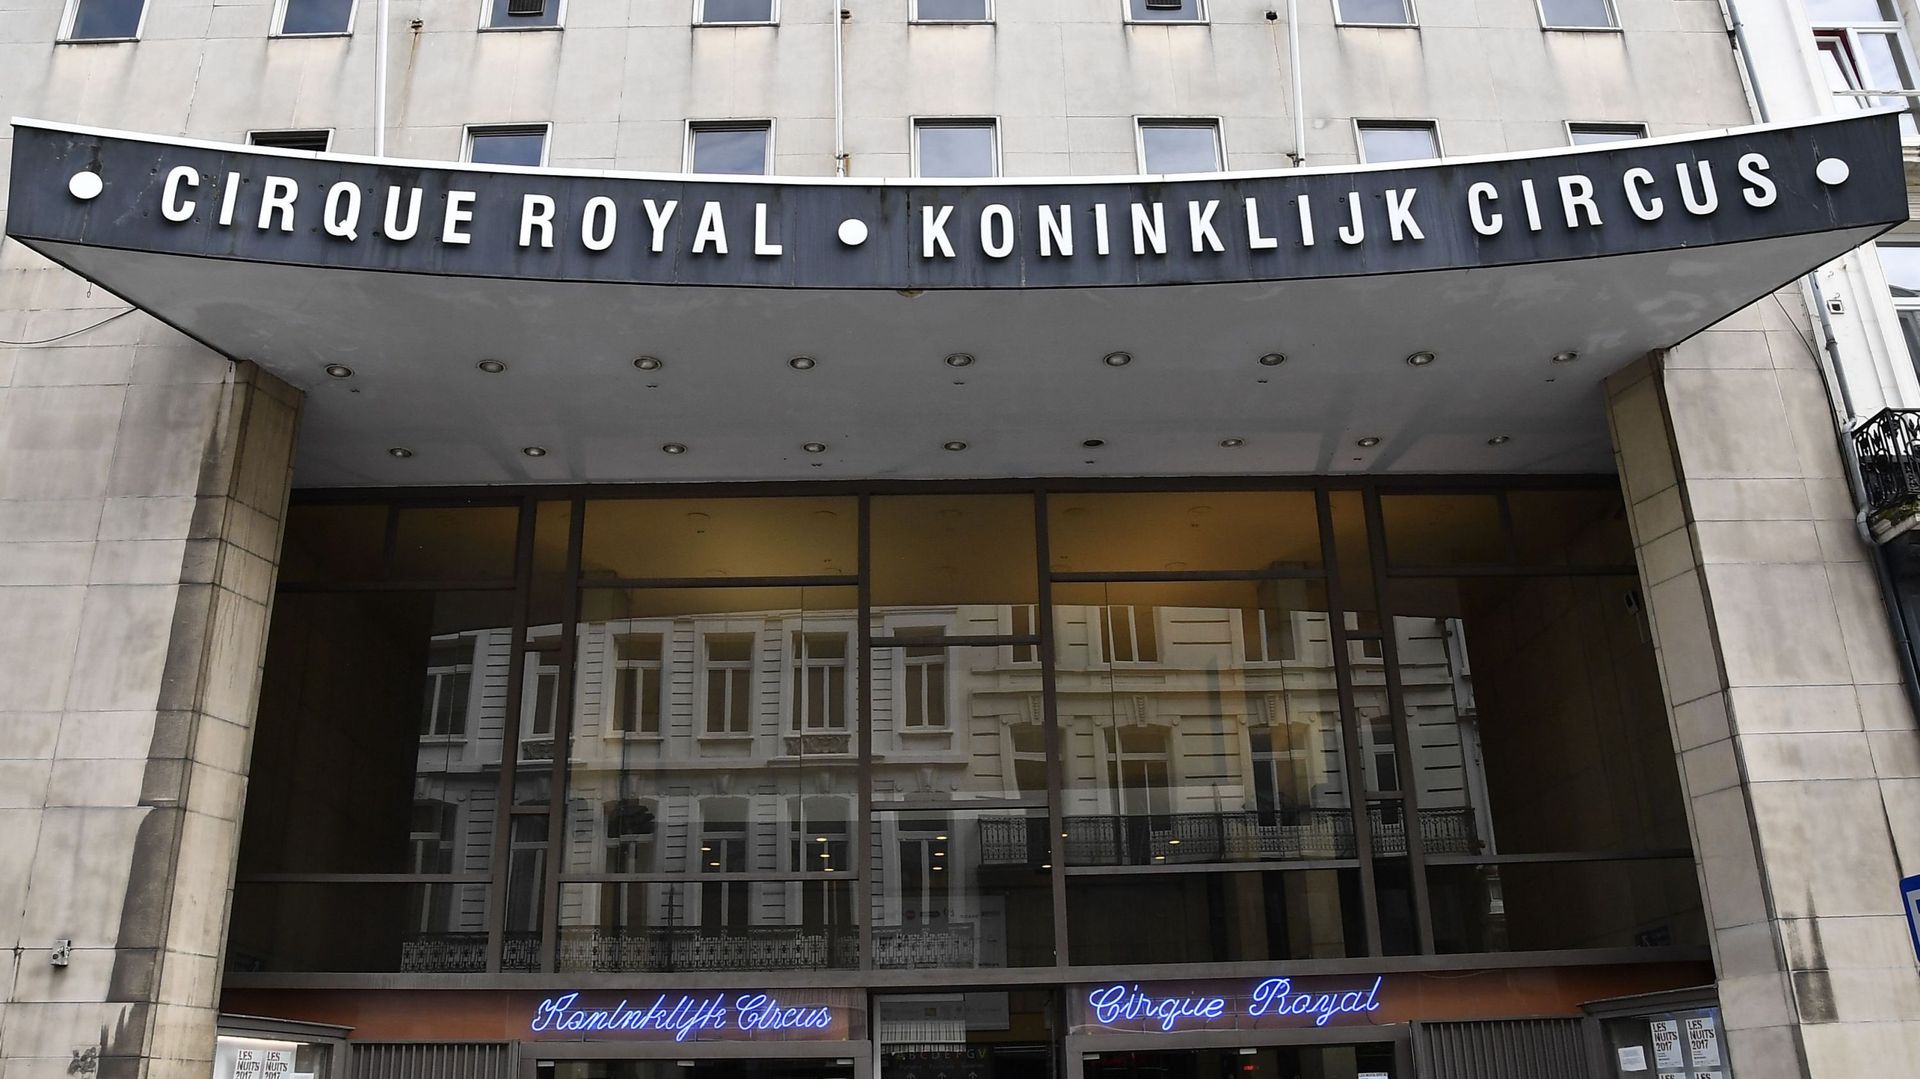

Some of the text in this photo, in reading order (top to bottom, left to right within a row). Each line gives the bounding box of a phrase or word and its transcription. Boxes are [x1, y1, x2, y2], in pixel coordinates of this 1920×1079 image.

[161, 165, 784, 256] CIRQUE ROYAL
[921, 153, 1778, 258] KONINKLIJK CIRCUS
[1089, 976, 1382, 1031] Cirque Royal
[736, 994, 832, 1031] Circus
[1652, 1022, 1667, 1032] LES
[1688, 1020, 1702, 1030] LES
[1654, 1031, 1678, 1042] NUITS
[1689, 1029, 1714, 1040] NUITS
[1656, 1041, 1672, 1051] 2017
[1692, 1039, 1709, 1050] 2017
[239, 1051, 253, 1060] LES
[267, 1052, 281, 1061] LES
[237, 1061, 260, 1071] NUITS
[265, 1062, 288, 1072] NUITS
[234, 1071, 252, 1079] 2017
